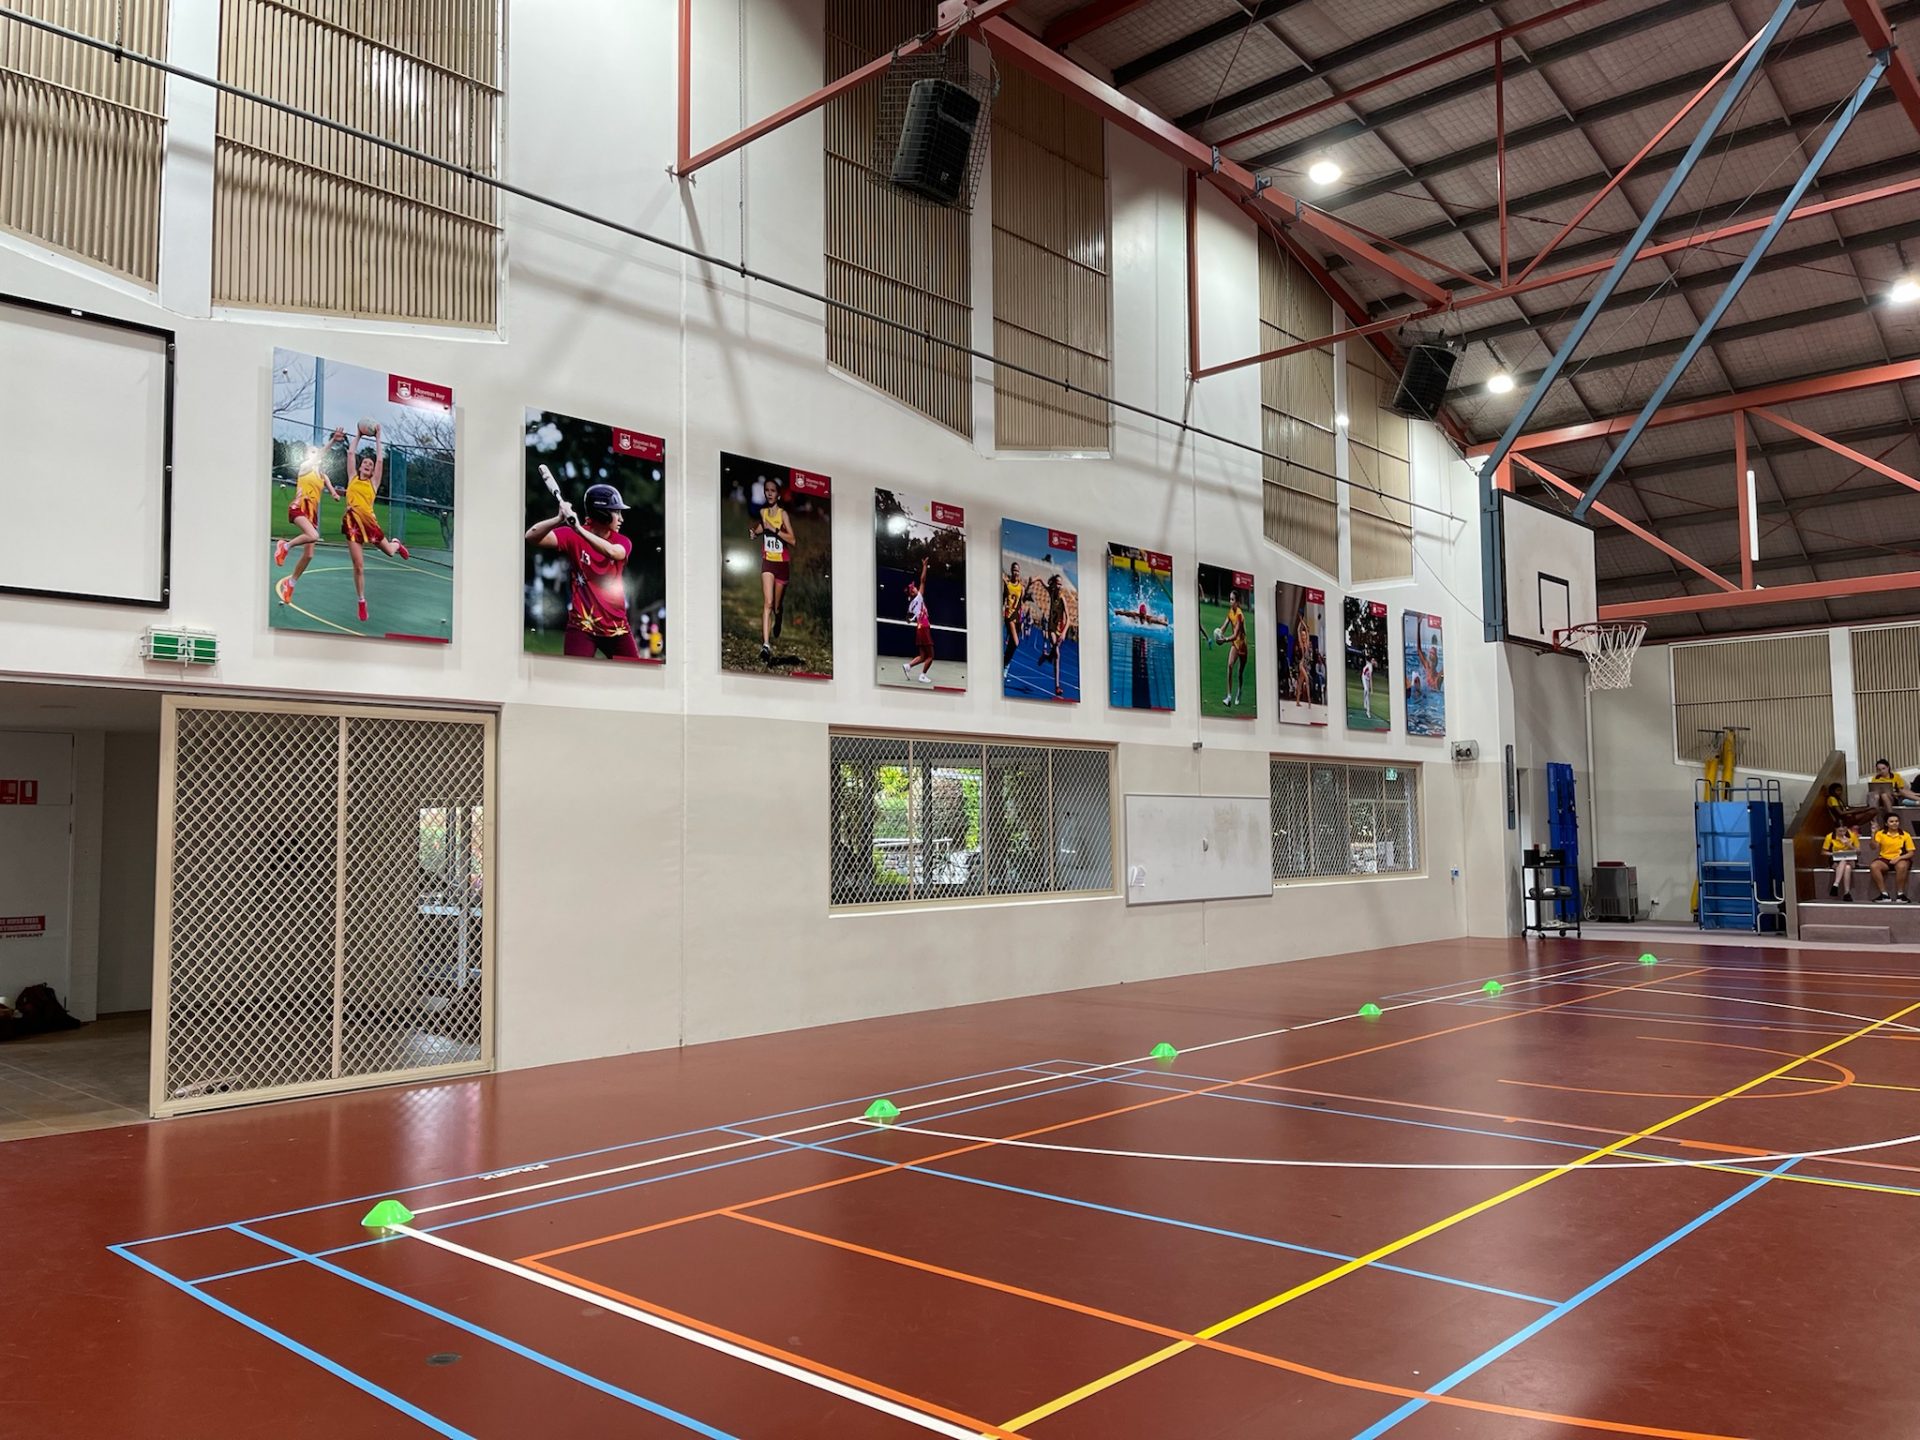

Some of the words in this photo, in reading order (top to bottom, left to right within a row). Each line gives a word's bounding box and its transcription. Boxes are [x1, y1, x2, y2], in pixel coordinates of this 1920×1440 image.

[435, 392, 445, 401] Bay
[766, 539, 780, 550] 416
[580, 549, 591, 566] 13
